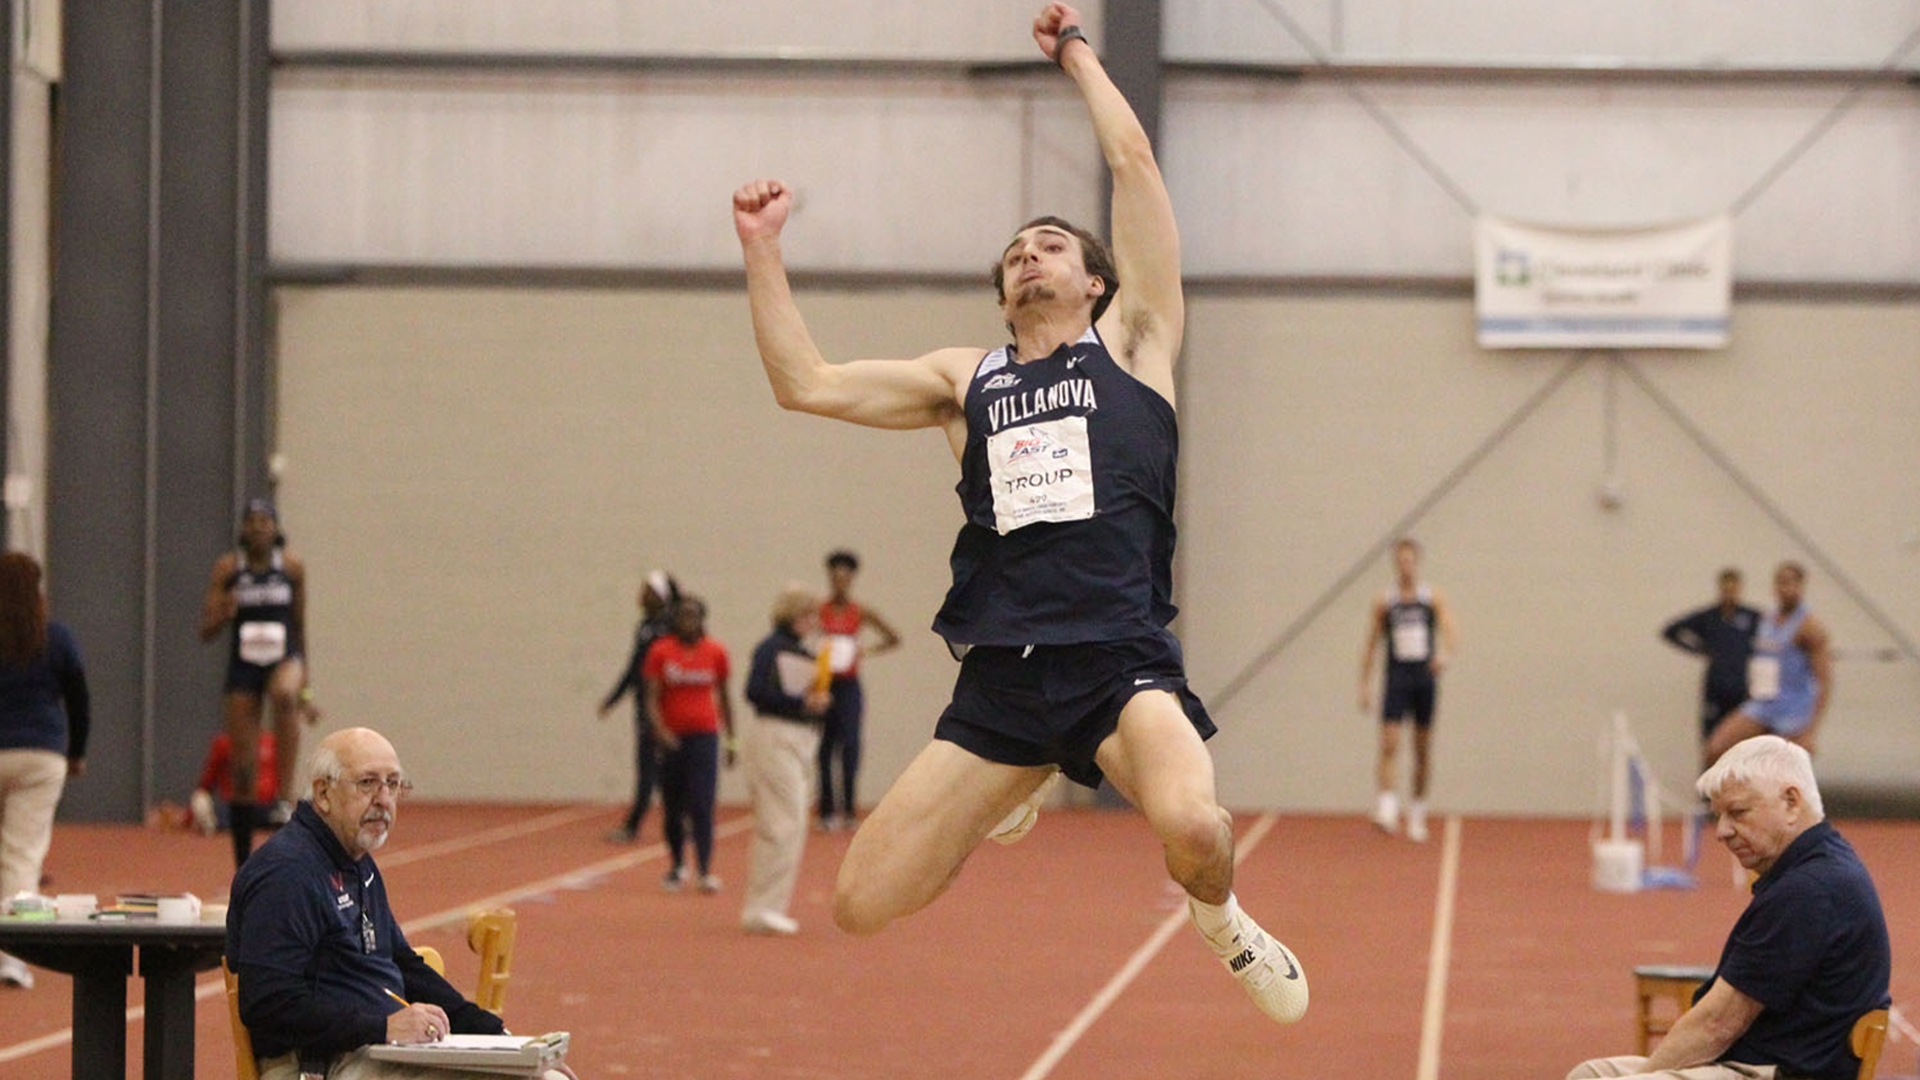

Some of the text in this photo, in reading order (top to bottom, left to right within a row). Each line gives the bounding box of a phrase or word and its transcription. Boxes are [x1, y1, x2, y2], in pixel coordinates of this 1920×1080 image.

[988, 379, 1097, 432] VILLANOVA
[1006, 469, 1073, 493] TROUP
[1229, 949, 1256, 973] NIKE
